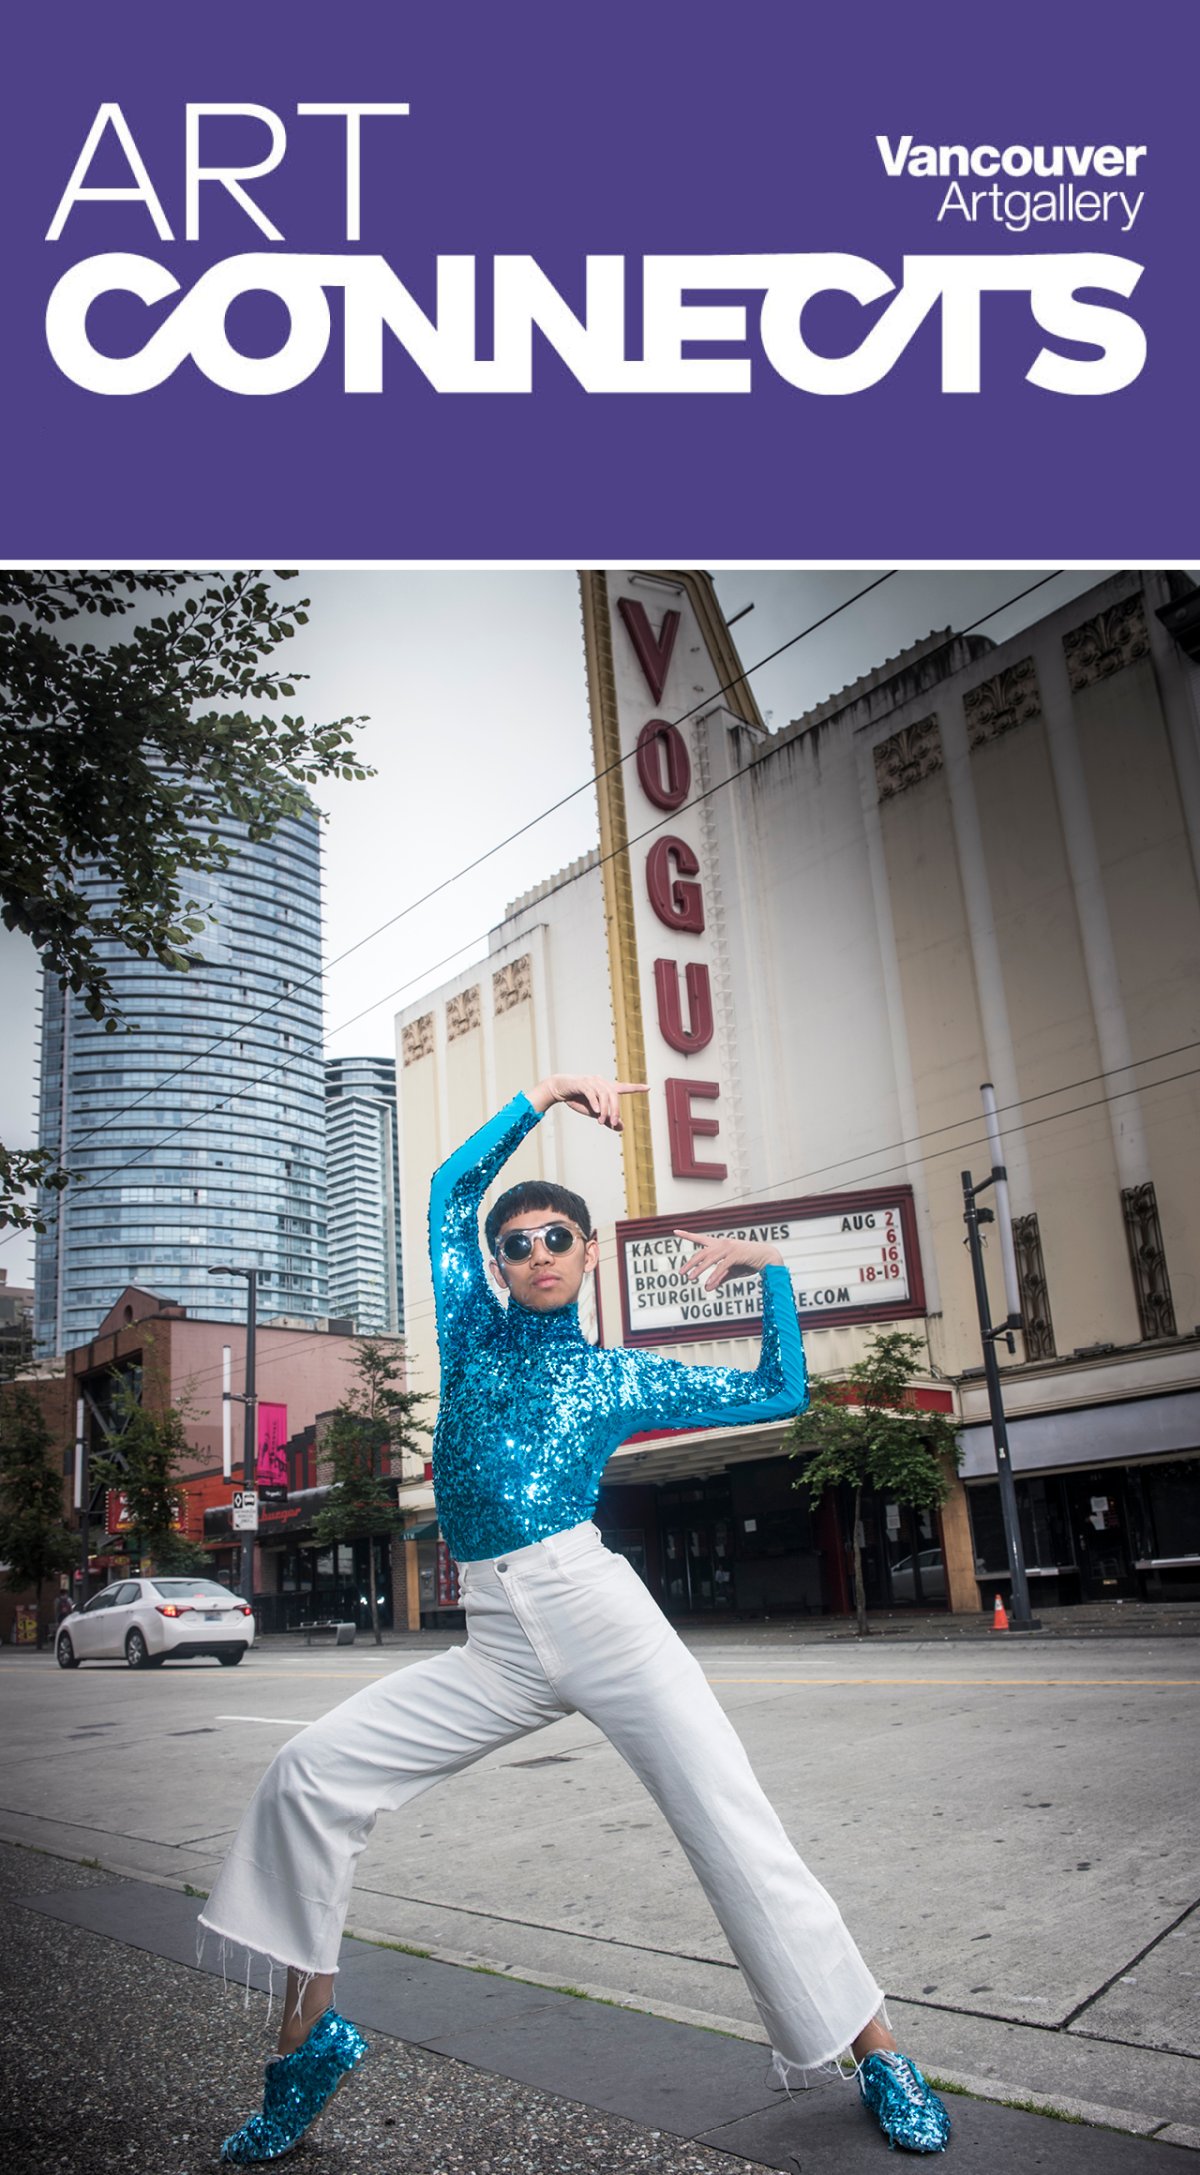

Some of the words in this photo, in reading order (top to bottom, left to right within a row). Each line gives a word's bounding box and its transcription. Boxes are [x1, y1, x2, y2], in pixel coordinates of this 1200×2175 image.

[617, 596, 728, 1180] VOGUE
[632, 1238, 683, 1257] KACEY
[842, 1214, 876, 1232] AUG
[885, 1211, 894, 1226] 2
[634, 1258, 658, 1274] LIL
[886, 1229, 897, 1243] 6
[882, 1246, 899, 1262] 16
[638, 1289, 706, 1308] STURGIL
[716, 1280, 764, 1299] SIMPS
[859, 1264, 900, 1282] 18-19
